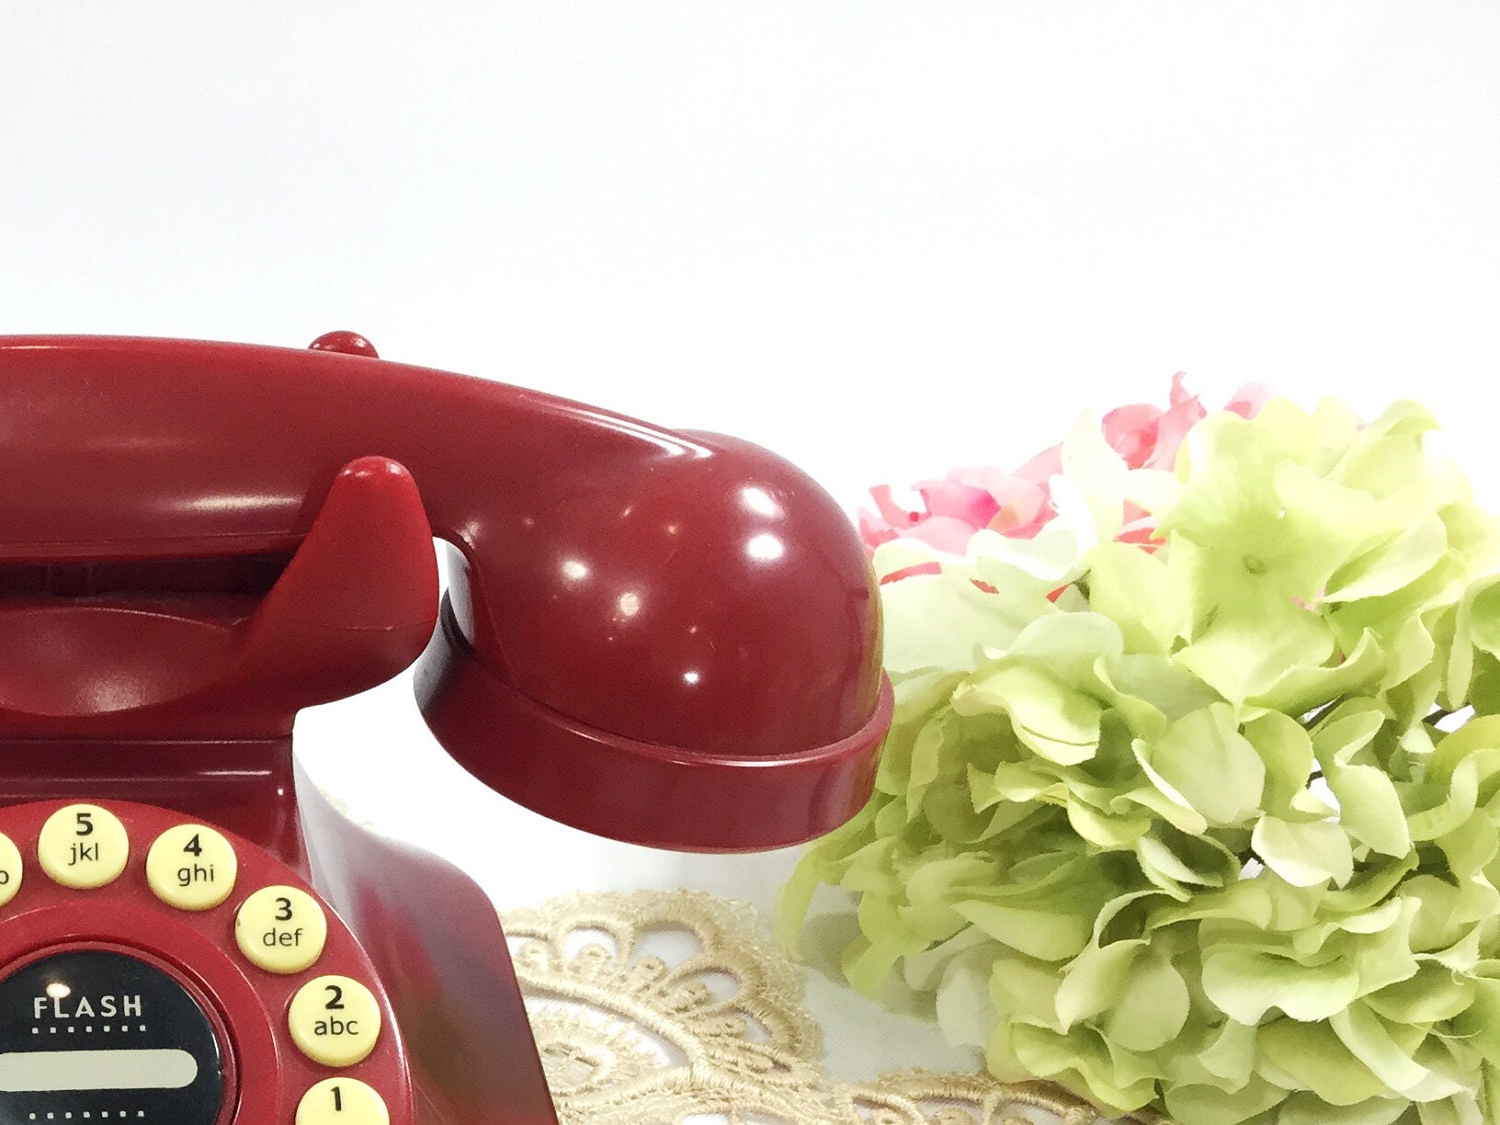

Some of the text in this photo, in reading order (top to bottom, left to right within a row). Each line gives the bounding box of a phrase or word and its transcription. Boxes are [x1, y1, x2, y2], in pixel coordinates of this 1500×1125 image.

[75, 812, 93, 836] 5
[68, 843, 99, 866] jkl
[183, 833, 202, 857] 4
[177, 863, 214, 887] ghi
[274, 898, 293, 921] 3
[262, 928, 303, 947] def
[33, 995, 143, 1018] FLASH
[324, 985, 344, 1009] 2
[313, 1014, 359, 1036] abc
[330, 1086, 342, 1111] 1
